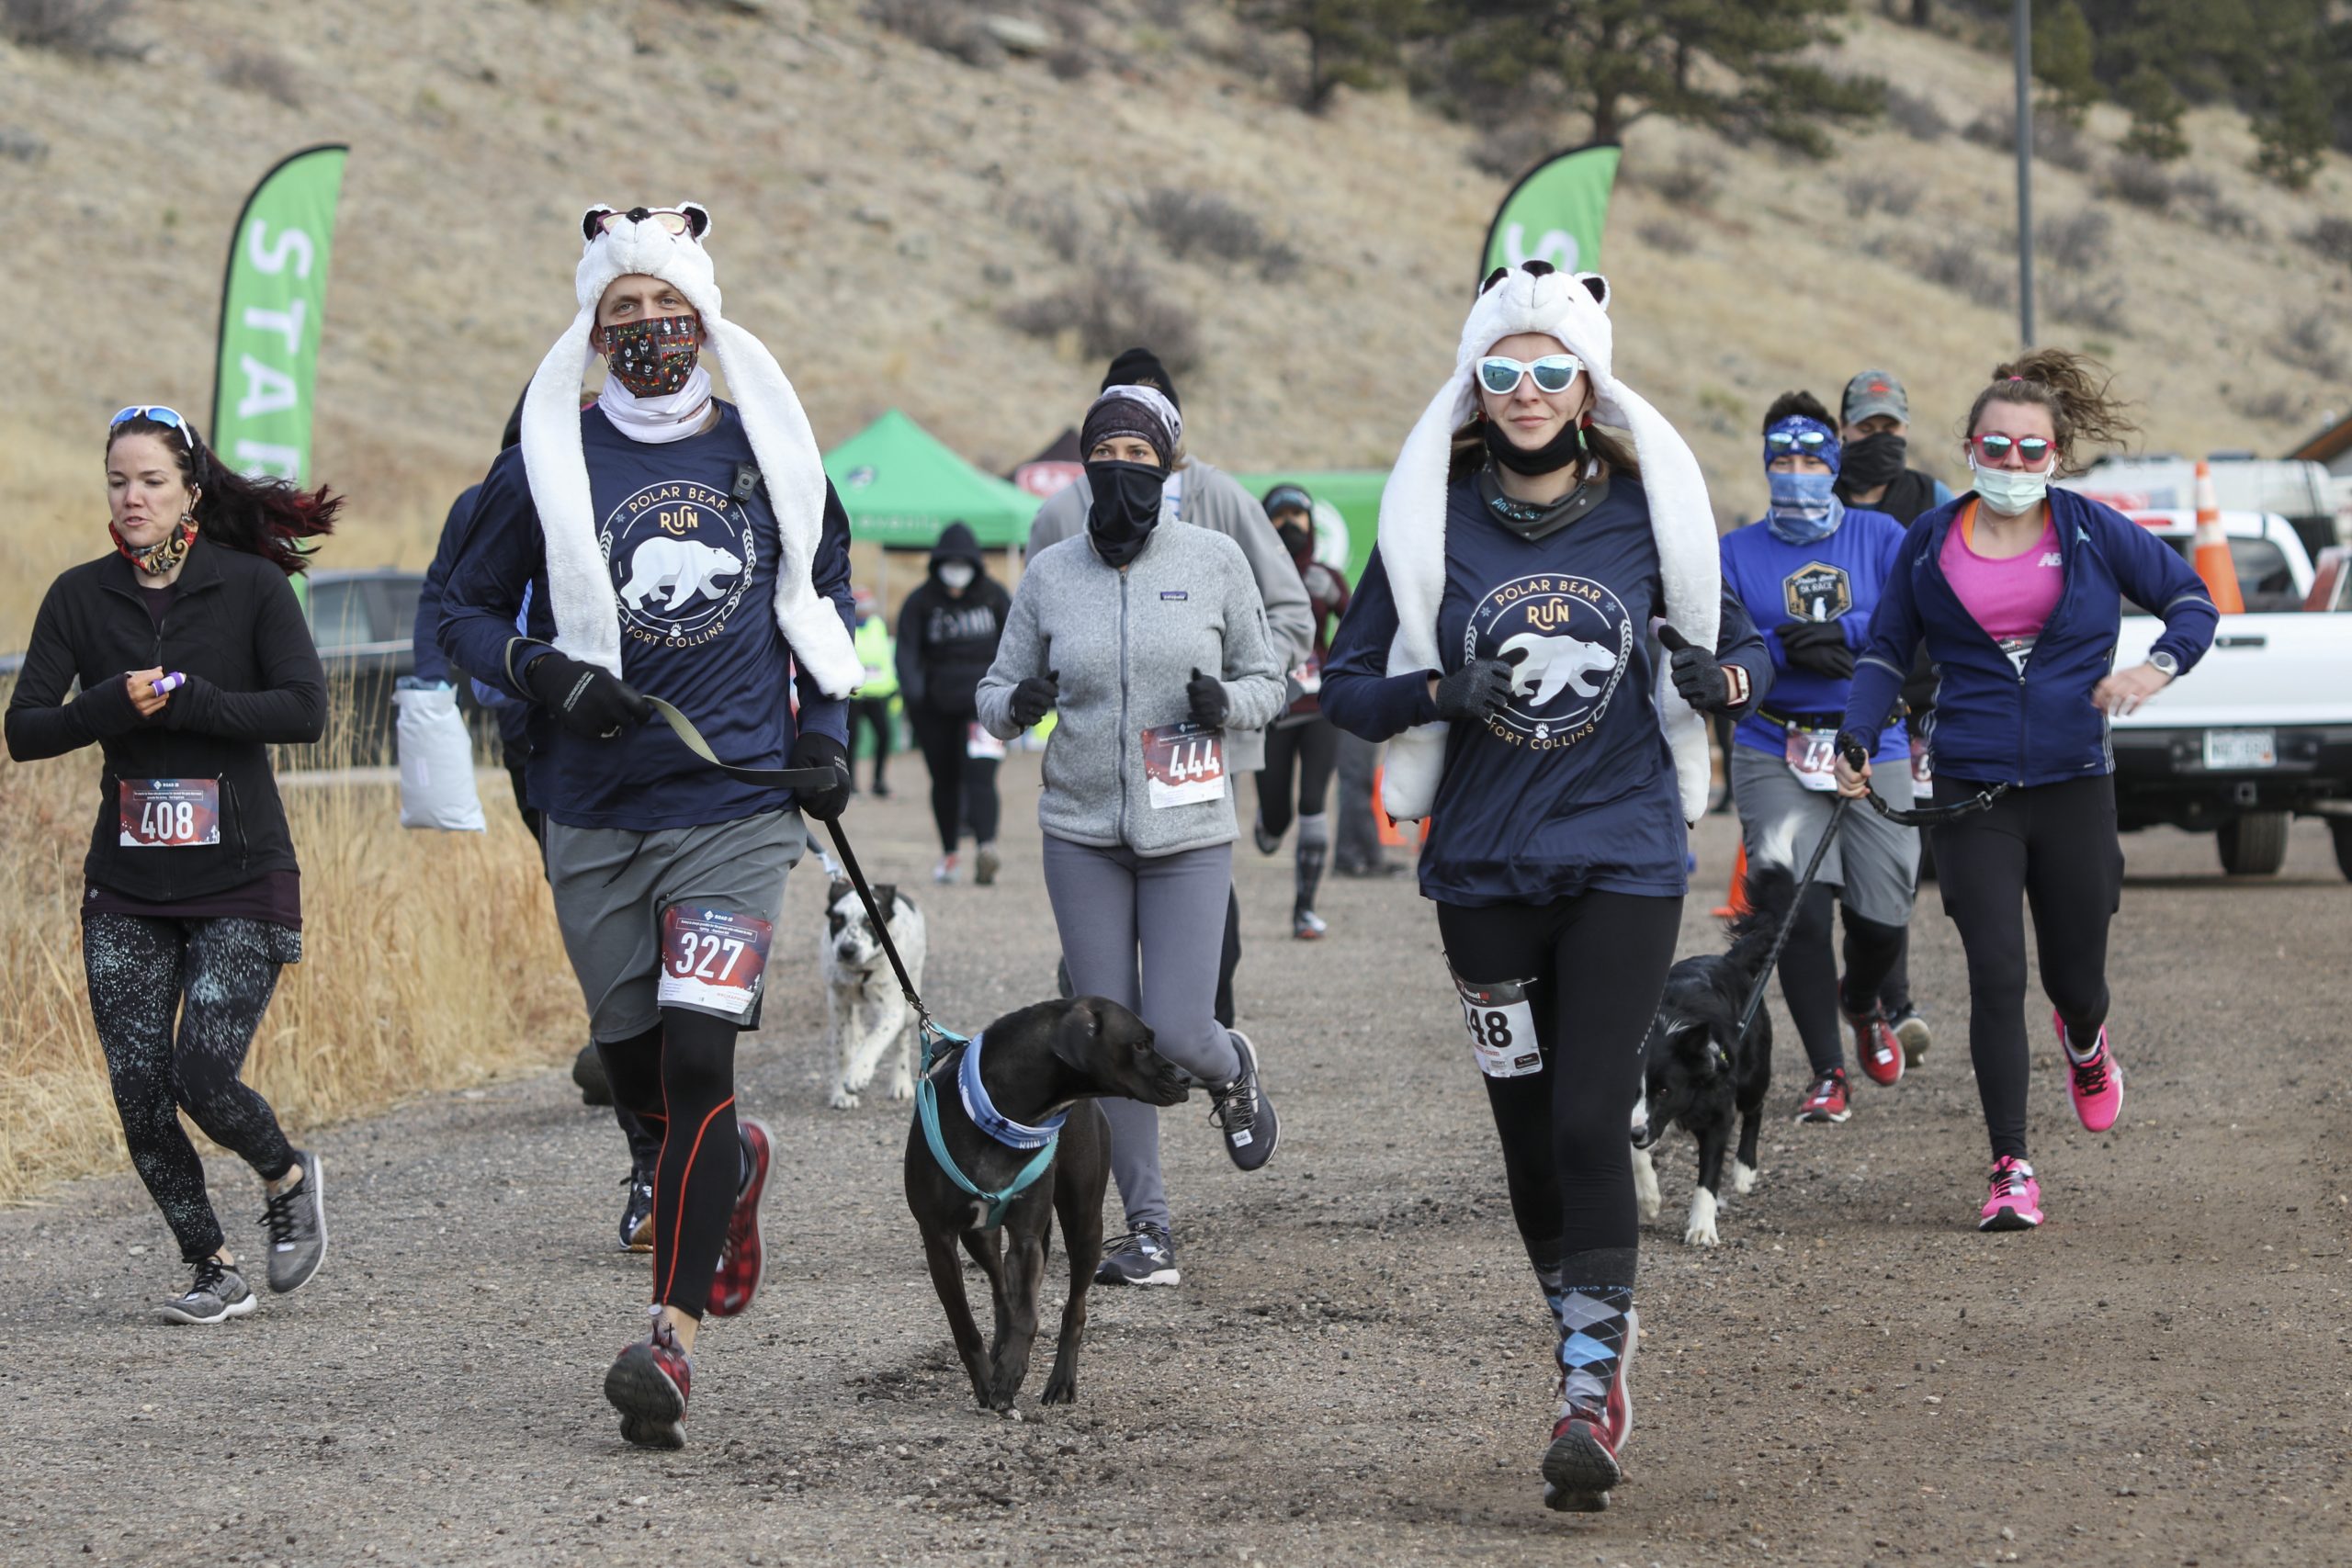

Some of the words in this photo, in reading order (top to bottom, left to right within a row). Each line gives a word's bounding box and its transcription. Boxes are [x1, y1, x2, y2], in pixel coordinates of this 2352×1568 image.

[236, 218, 314, 488] STAR
[628, 486, 680, 513] POLAR
[689, 488, 728, 512] BEAR
[660, 505, 698, 536] RUN
[1494, 580, 1551, 606] POLAR
[1558, 581, 1601, 603] BEAR
[1527, 597, 1570, 631] RUN
[626, 625, 660, 646] FORT
[665, 621, 725, 649] COLLINS
[1487, 722, 1524, 747] FORT
[1531, 723, 1595, 750] COLLINS
[1169, 739, 1221, 781] 444
[141, 801, 194, 840] 408
[675, 931, 745, 981] 327
[1459, 995, 1512, 1048] 48
